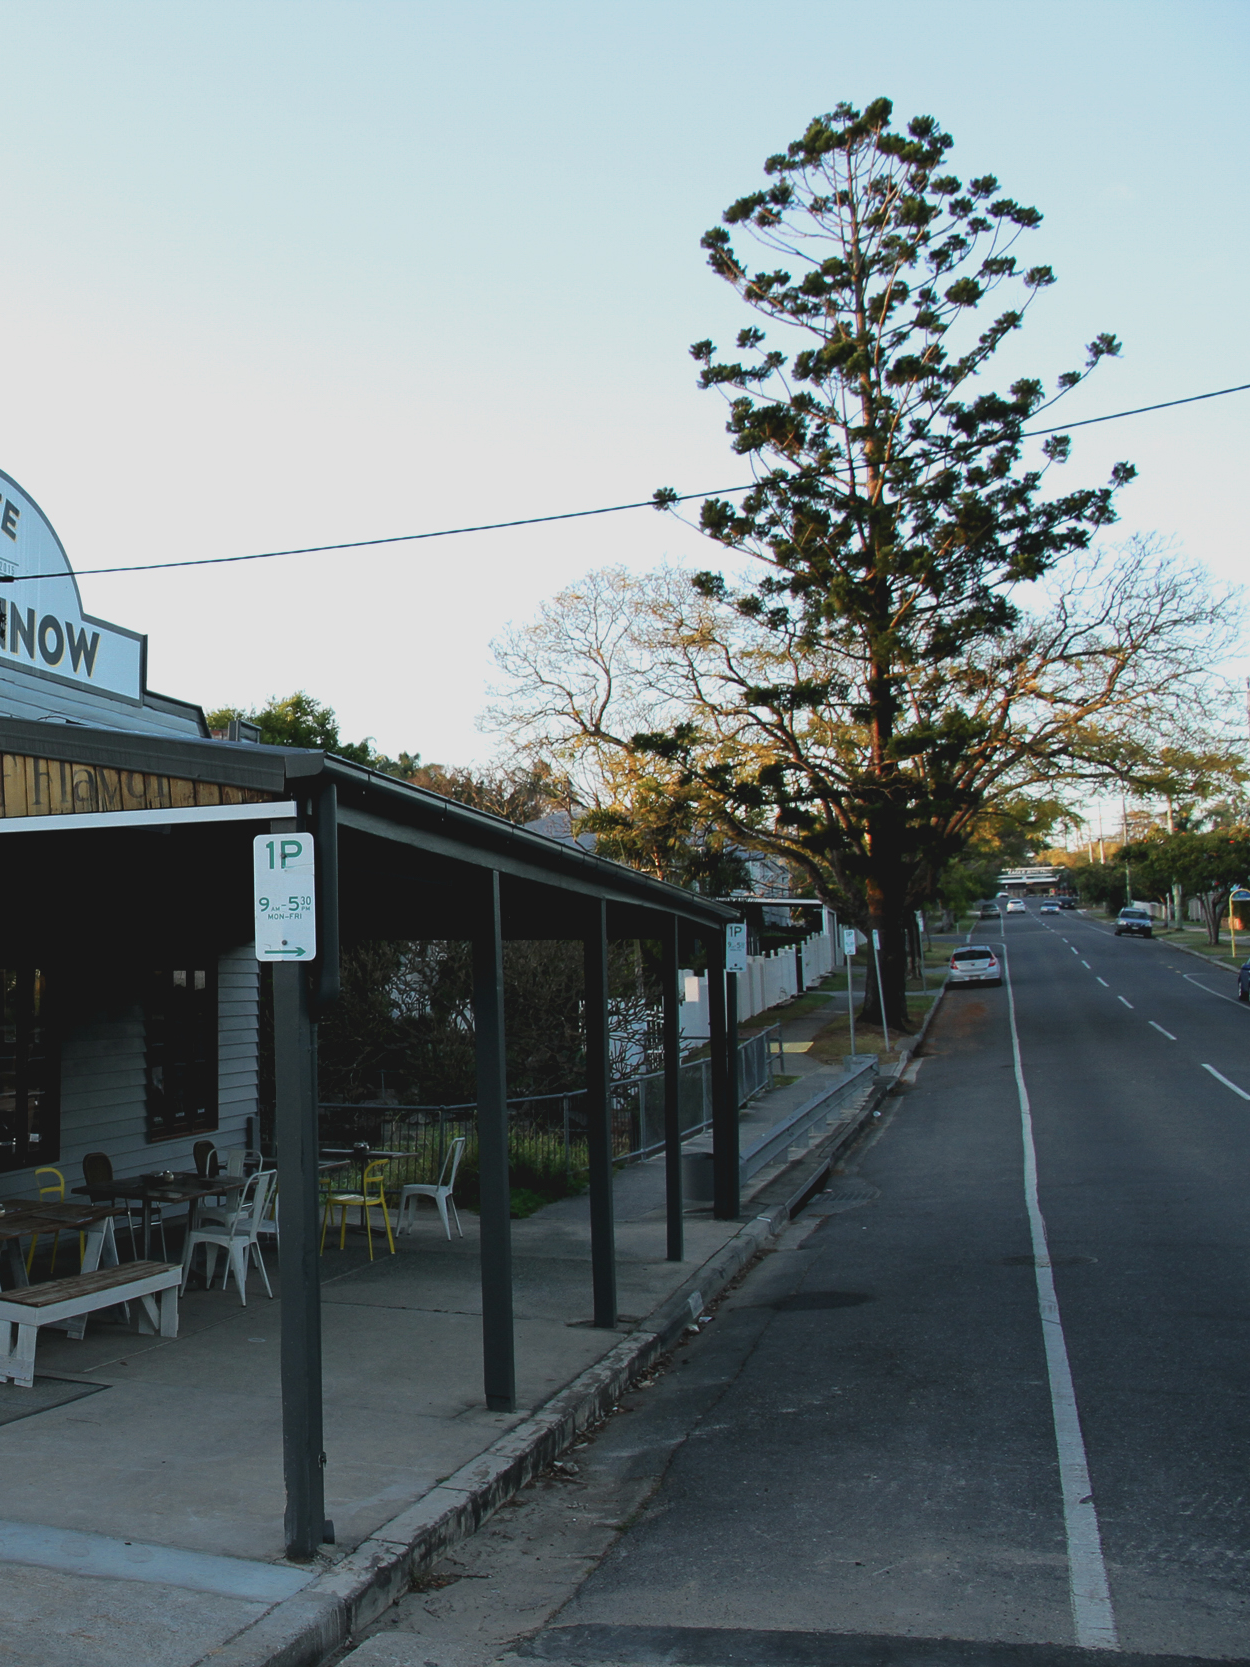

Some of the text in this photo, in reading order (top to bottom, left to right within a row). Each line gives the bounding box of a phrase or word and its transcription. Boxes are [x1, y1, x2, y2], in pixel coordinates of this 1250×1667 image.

[0, 561, 15, 576] 2015
[265, 840, 303, 869] 1P
[729, 926, 742, 937] 1P
